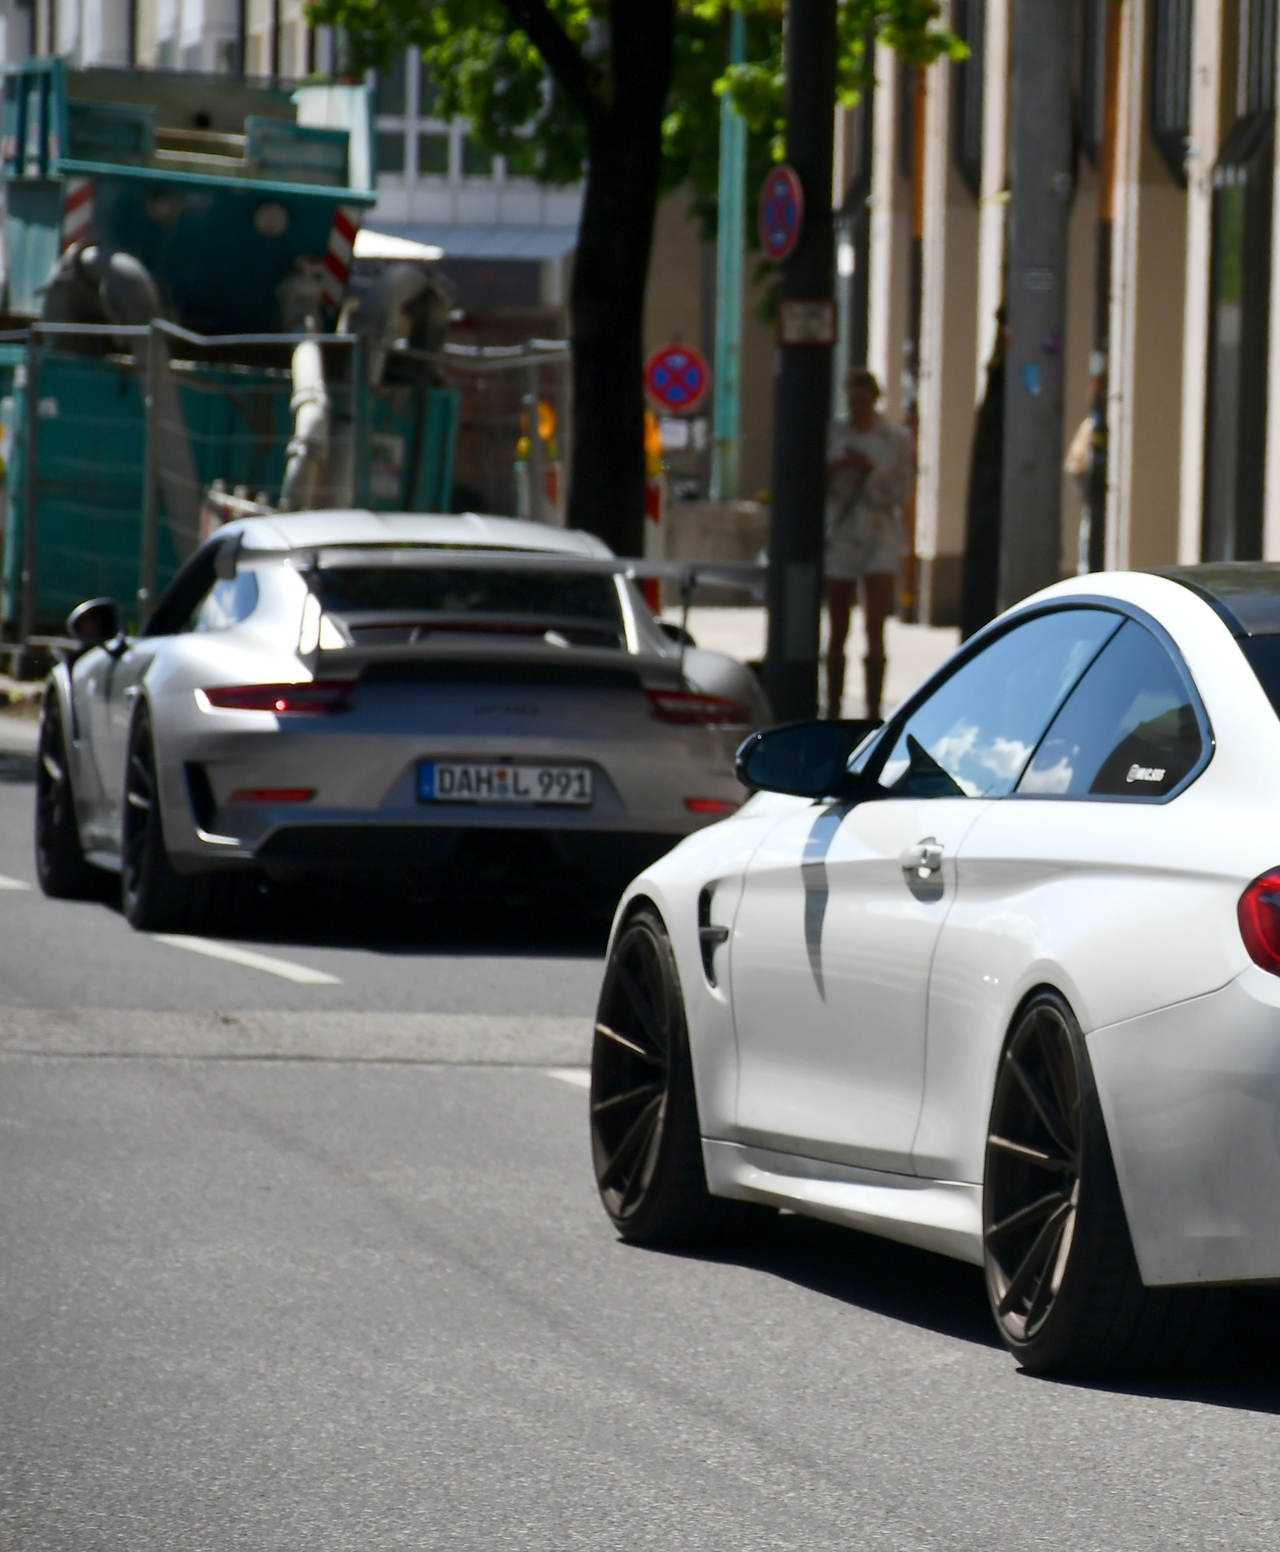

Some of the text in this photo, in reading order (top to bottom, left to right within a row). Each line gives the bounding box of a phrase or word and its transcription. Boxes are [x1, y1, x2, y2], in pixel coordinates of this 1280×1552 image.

[438, 768, 588, 798] DAH L 991
